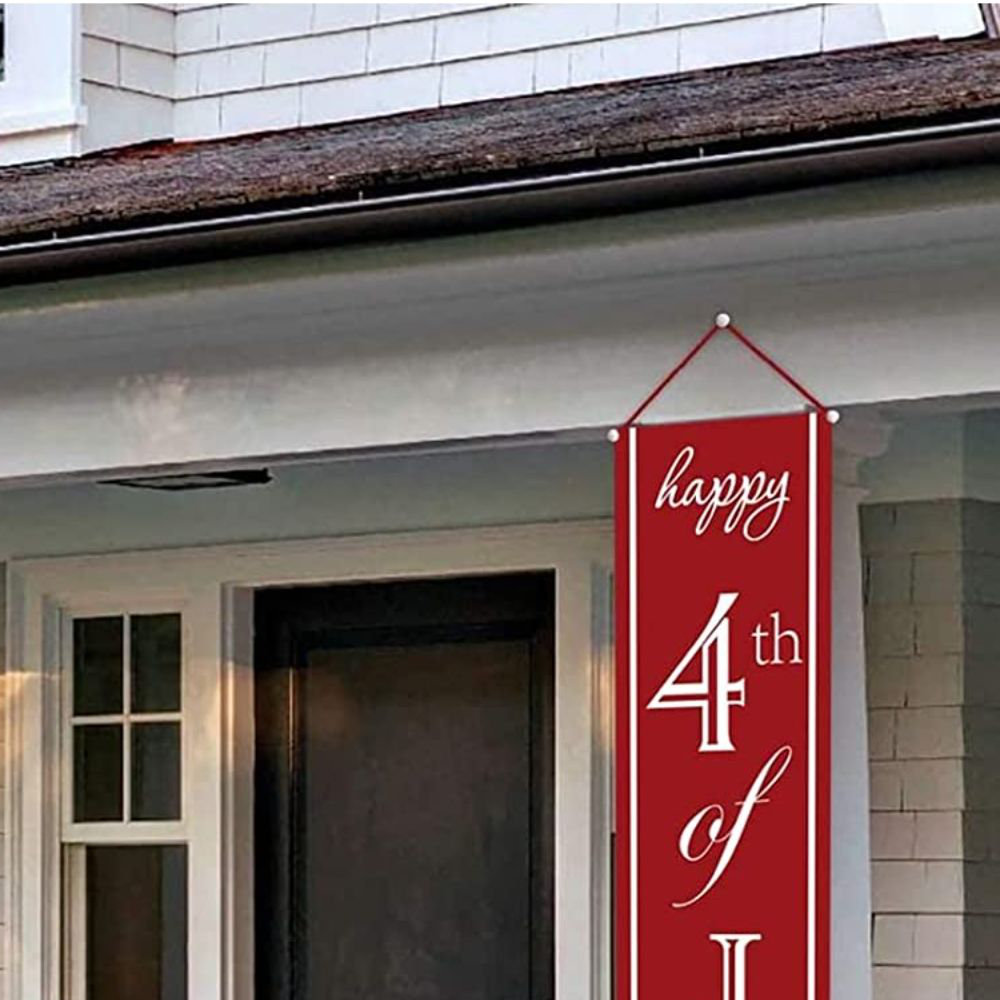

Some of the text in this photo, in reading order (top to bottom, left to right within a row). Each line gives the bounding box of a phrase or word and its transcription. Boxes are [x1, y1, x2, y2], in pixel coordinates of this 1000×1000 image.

[655, 446, 790, 542] happy
[646, 592, 803, 752] 4th
[672, 745, 793, 908] of
